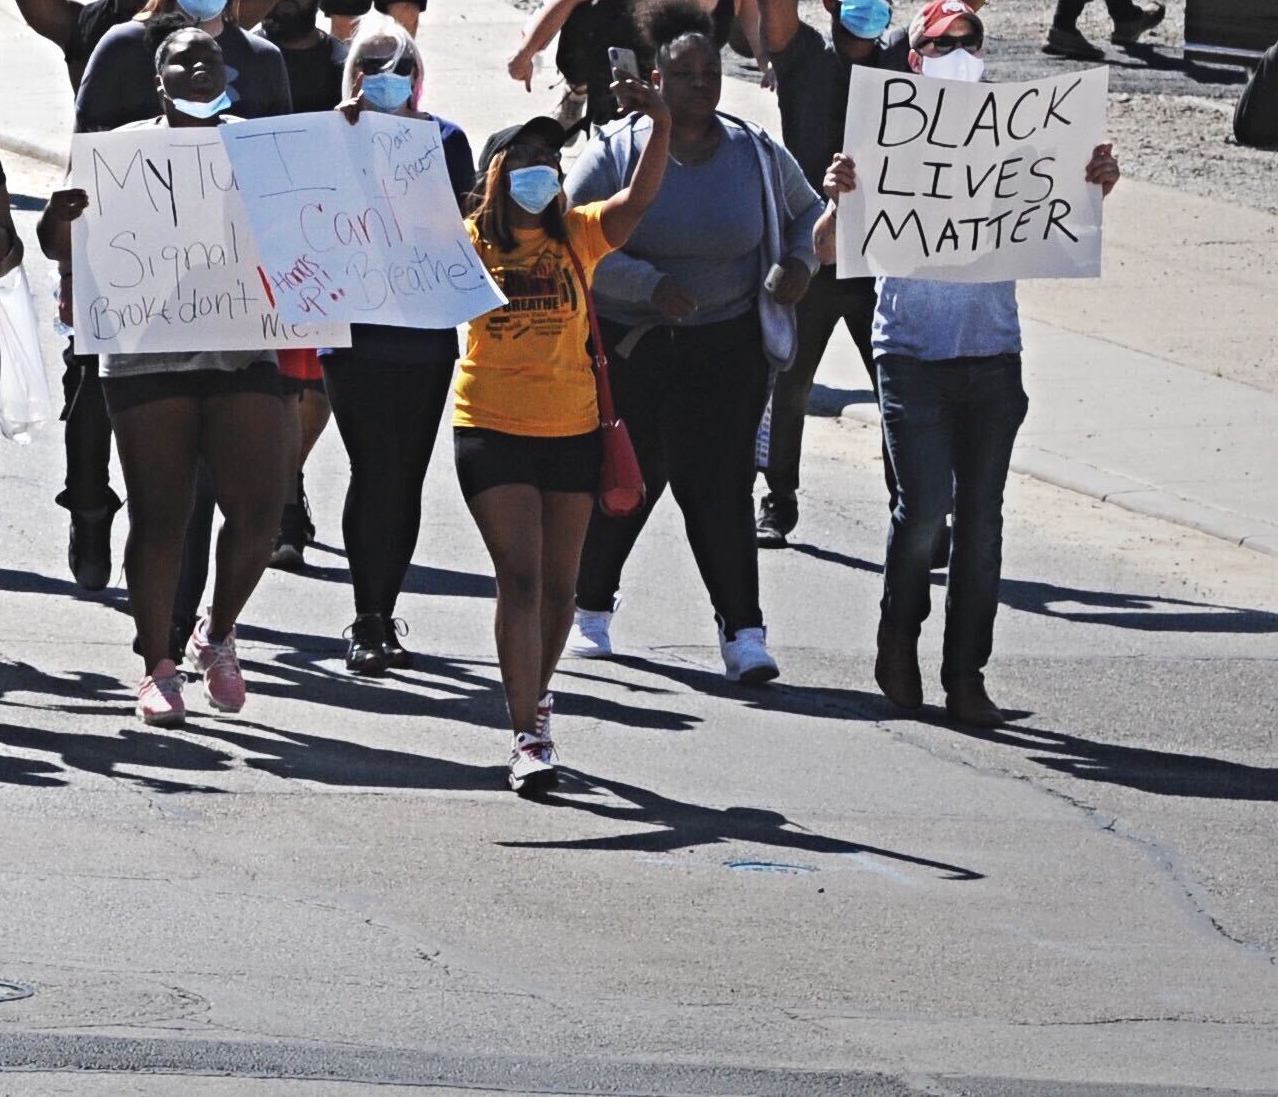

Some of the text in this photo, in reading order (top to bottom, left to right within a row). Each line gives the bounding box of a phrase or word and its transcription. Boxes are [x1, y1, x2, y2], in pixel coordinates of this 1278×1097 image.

[877, 77, 1082, 149] BLACK
[91, 141, 240, 228] My Tu
[234, 128, 338, 200] I
[878, 155, 1056, 204] LIVES
[108, 222, 240, 301] Signal
[861, 198, 1079, 258] MATTER
